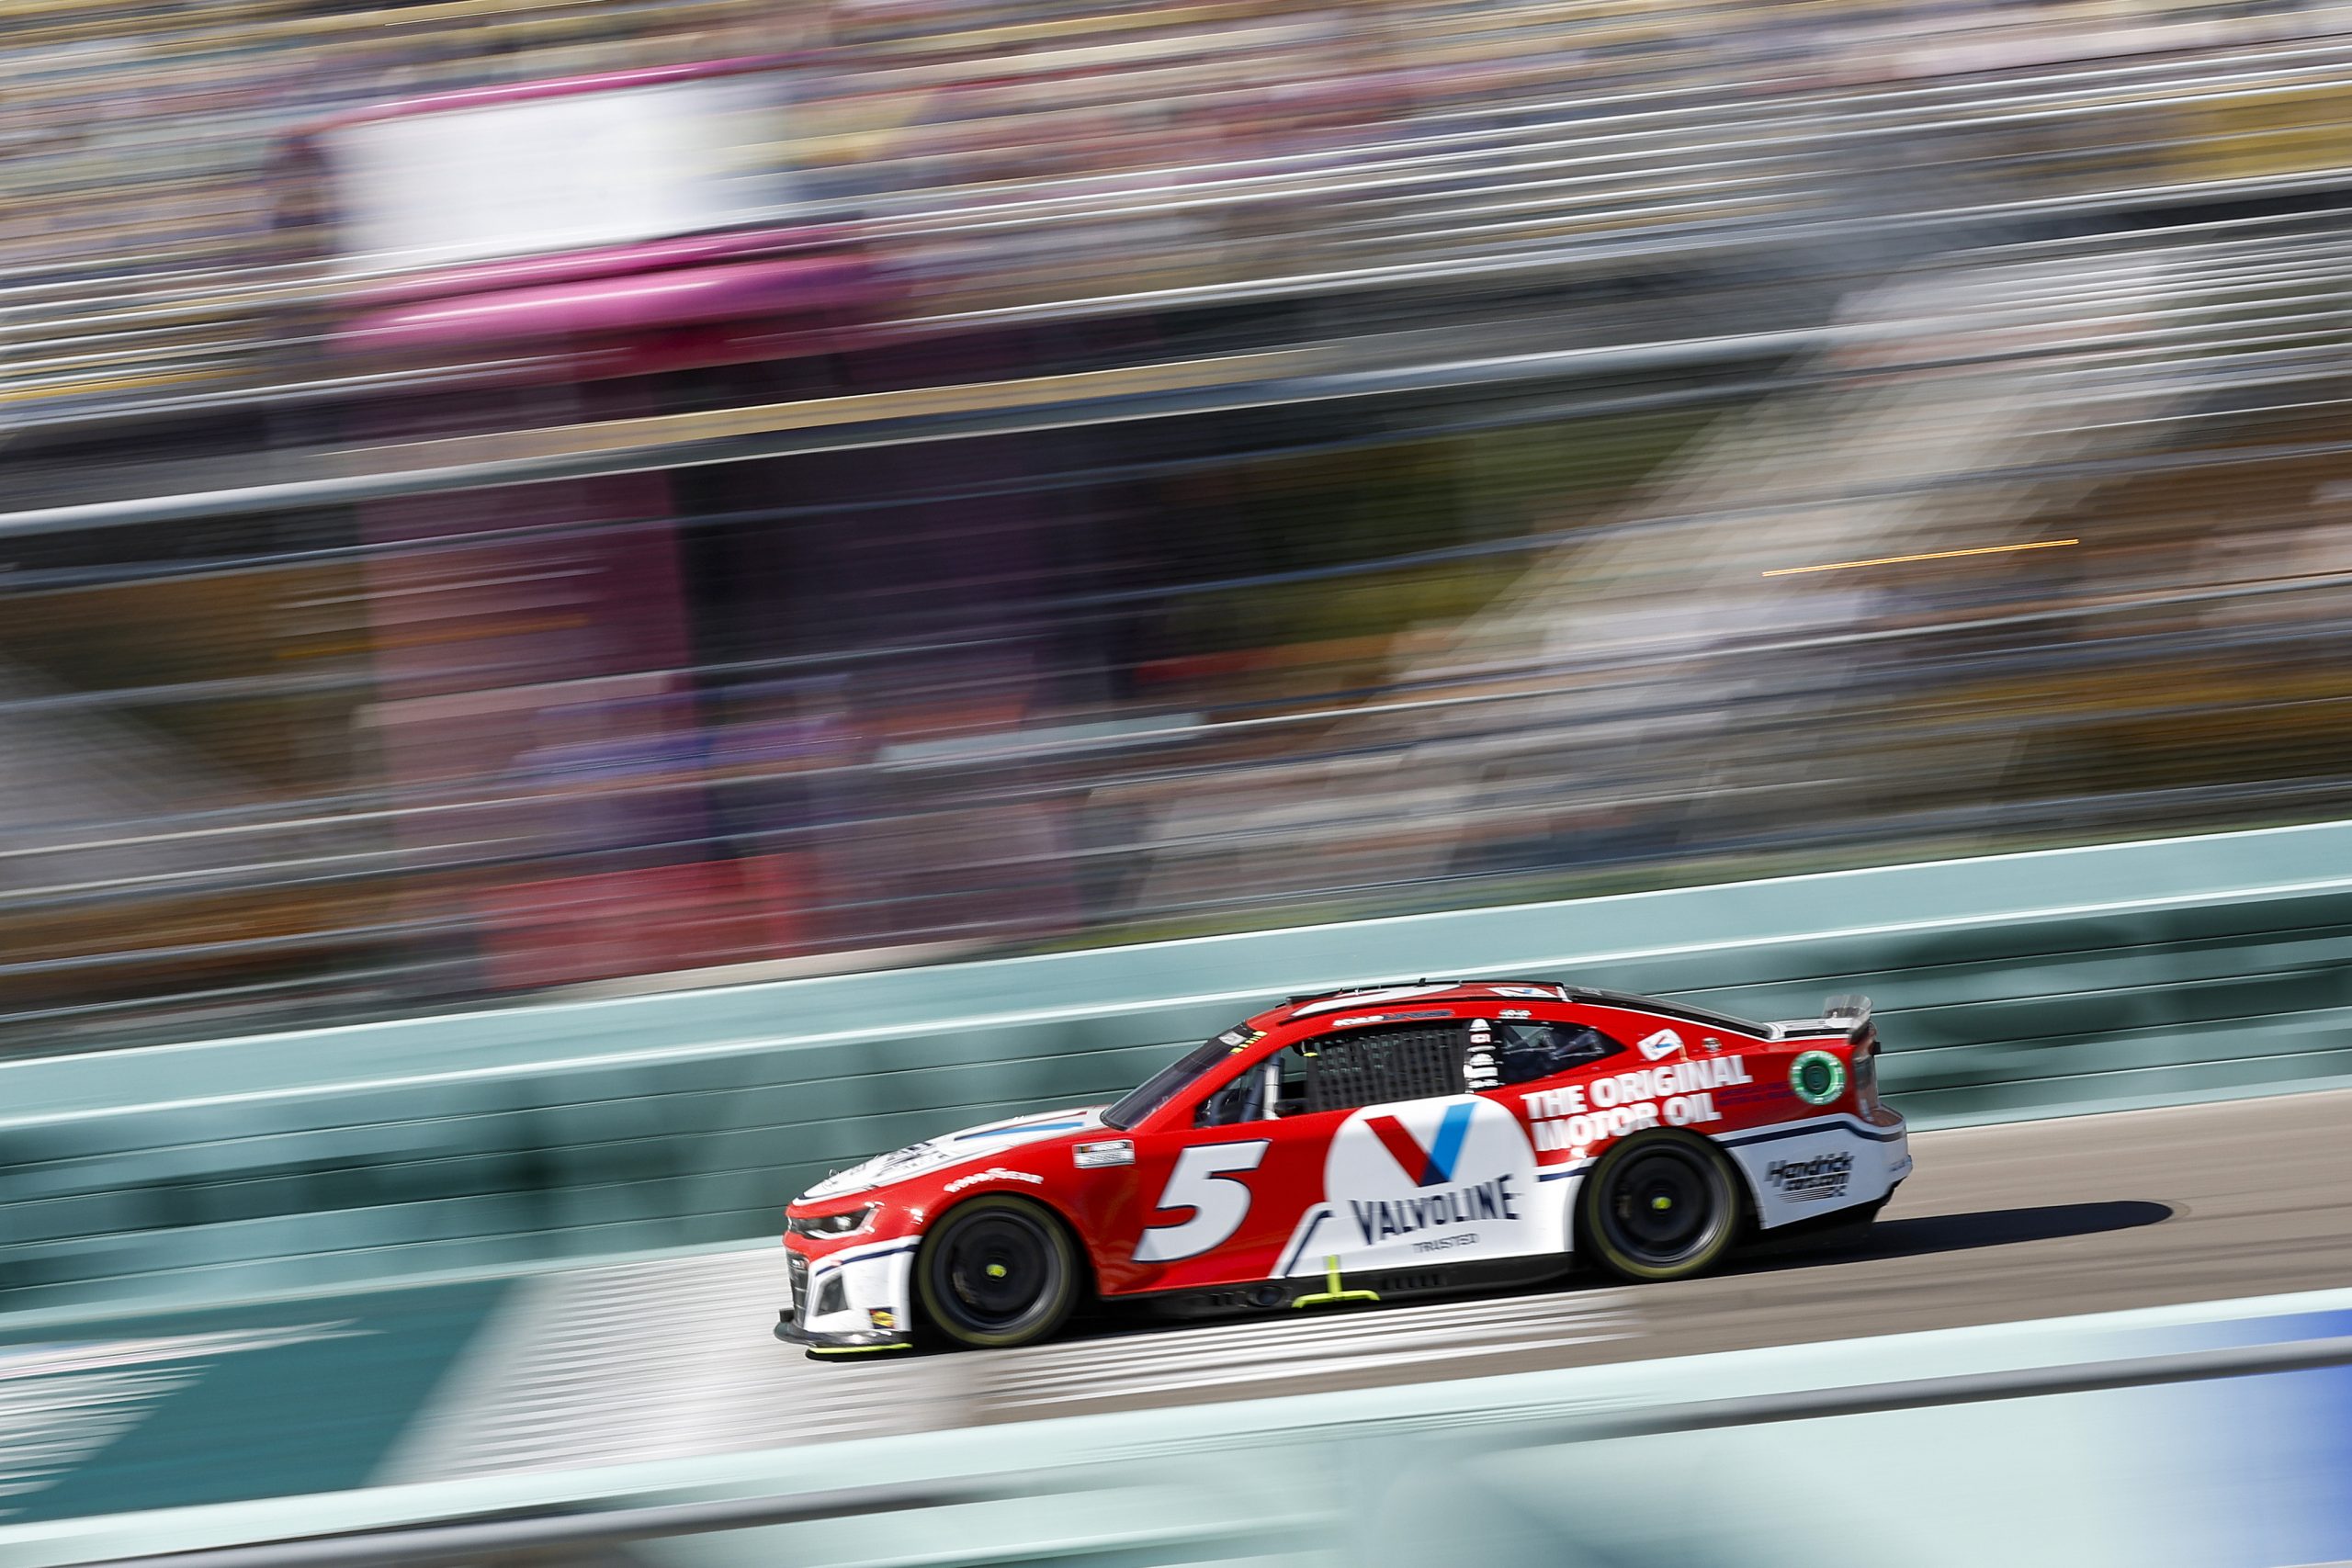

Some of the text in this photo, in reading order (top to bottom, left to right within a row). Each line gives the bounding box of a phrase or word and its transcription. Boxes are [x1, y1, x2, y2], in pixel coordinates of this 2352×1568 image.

[1521, 1085, 1588, 1119] THE
[1589, 1055, 1753, 1108] ORIGINAL
[1532, 1093, 1723, 1152] MOTOR OIL
[1765, 1152, 1855, 1187] Hendrick
[1133, 1139, 1272, 1262] 5
[1348, 1174, 1521, 1246] VALVOLINE
[1411, 1233, 1479, 1254] TRUSTED
